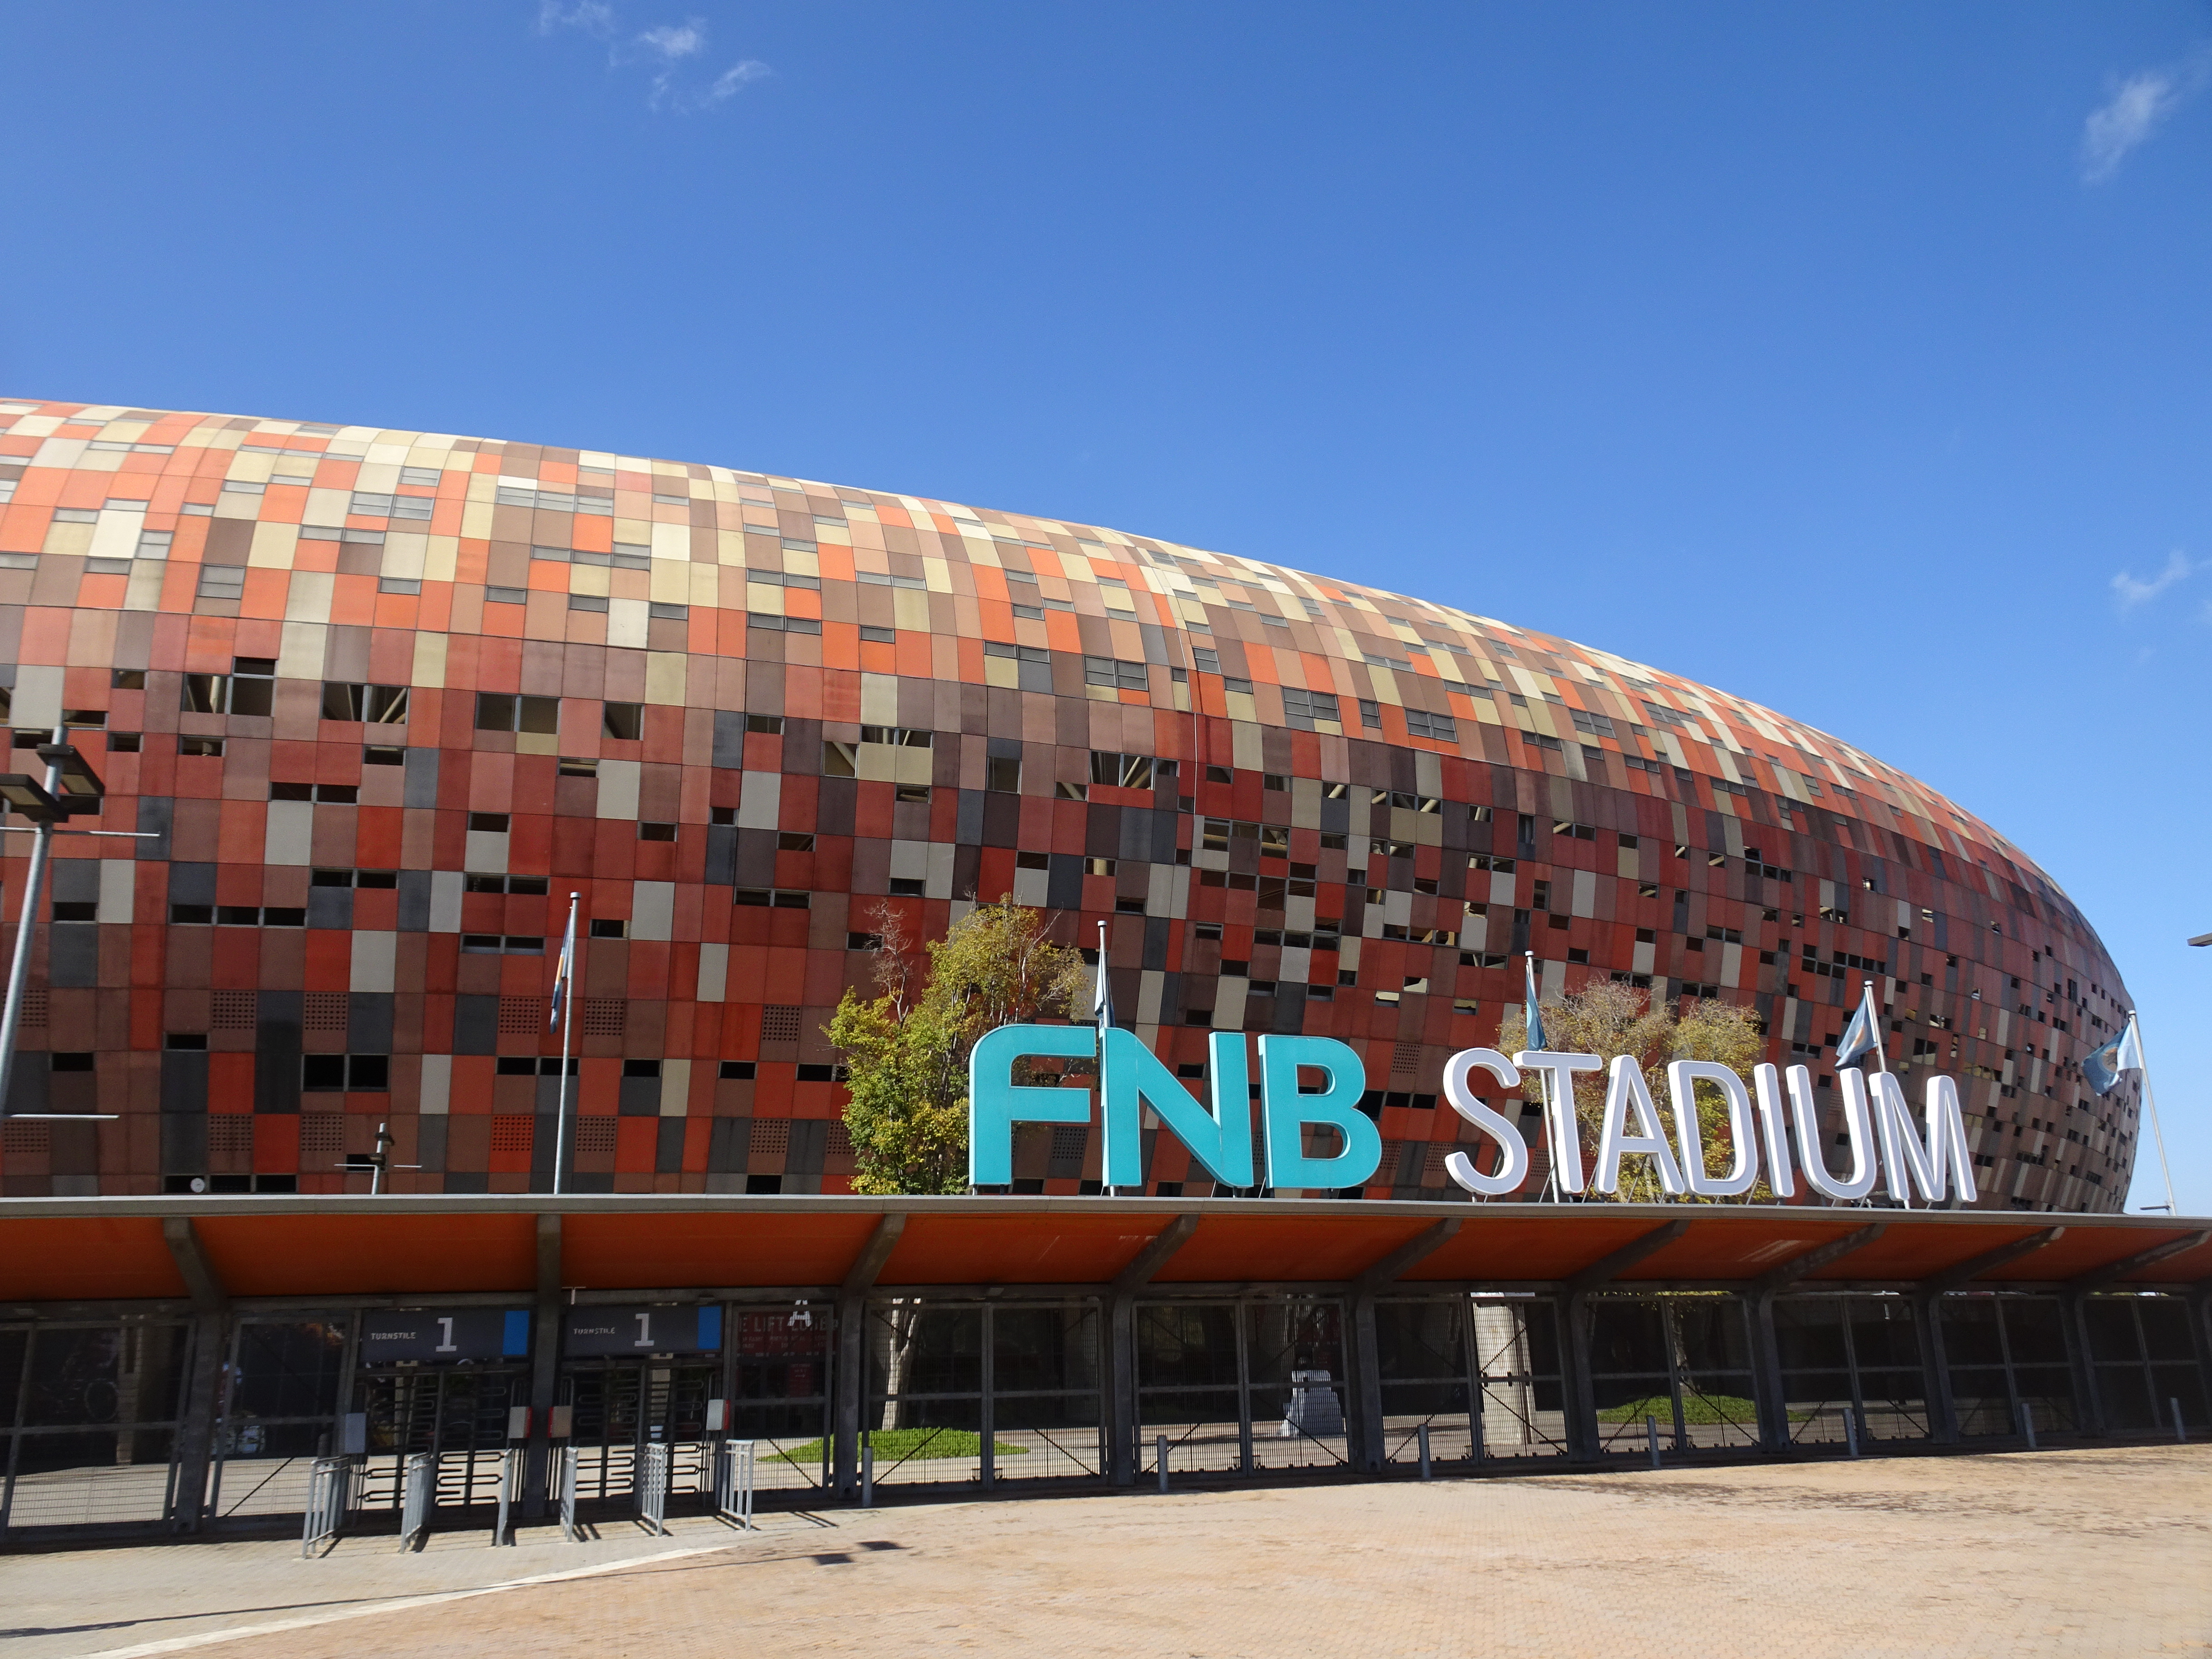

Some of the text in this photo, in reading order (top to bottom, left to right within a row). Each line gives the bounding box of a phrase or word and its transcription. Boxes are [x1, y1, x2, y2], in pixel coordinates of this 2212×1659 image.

[969, 1023, 1978, 1203] FNB STADIUM
[436, 1317, 457, 1352] 1
[634, 1313, 655, 1347] 1
